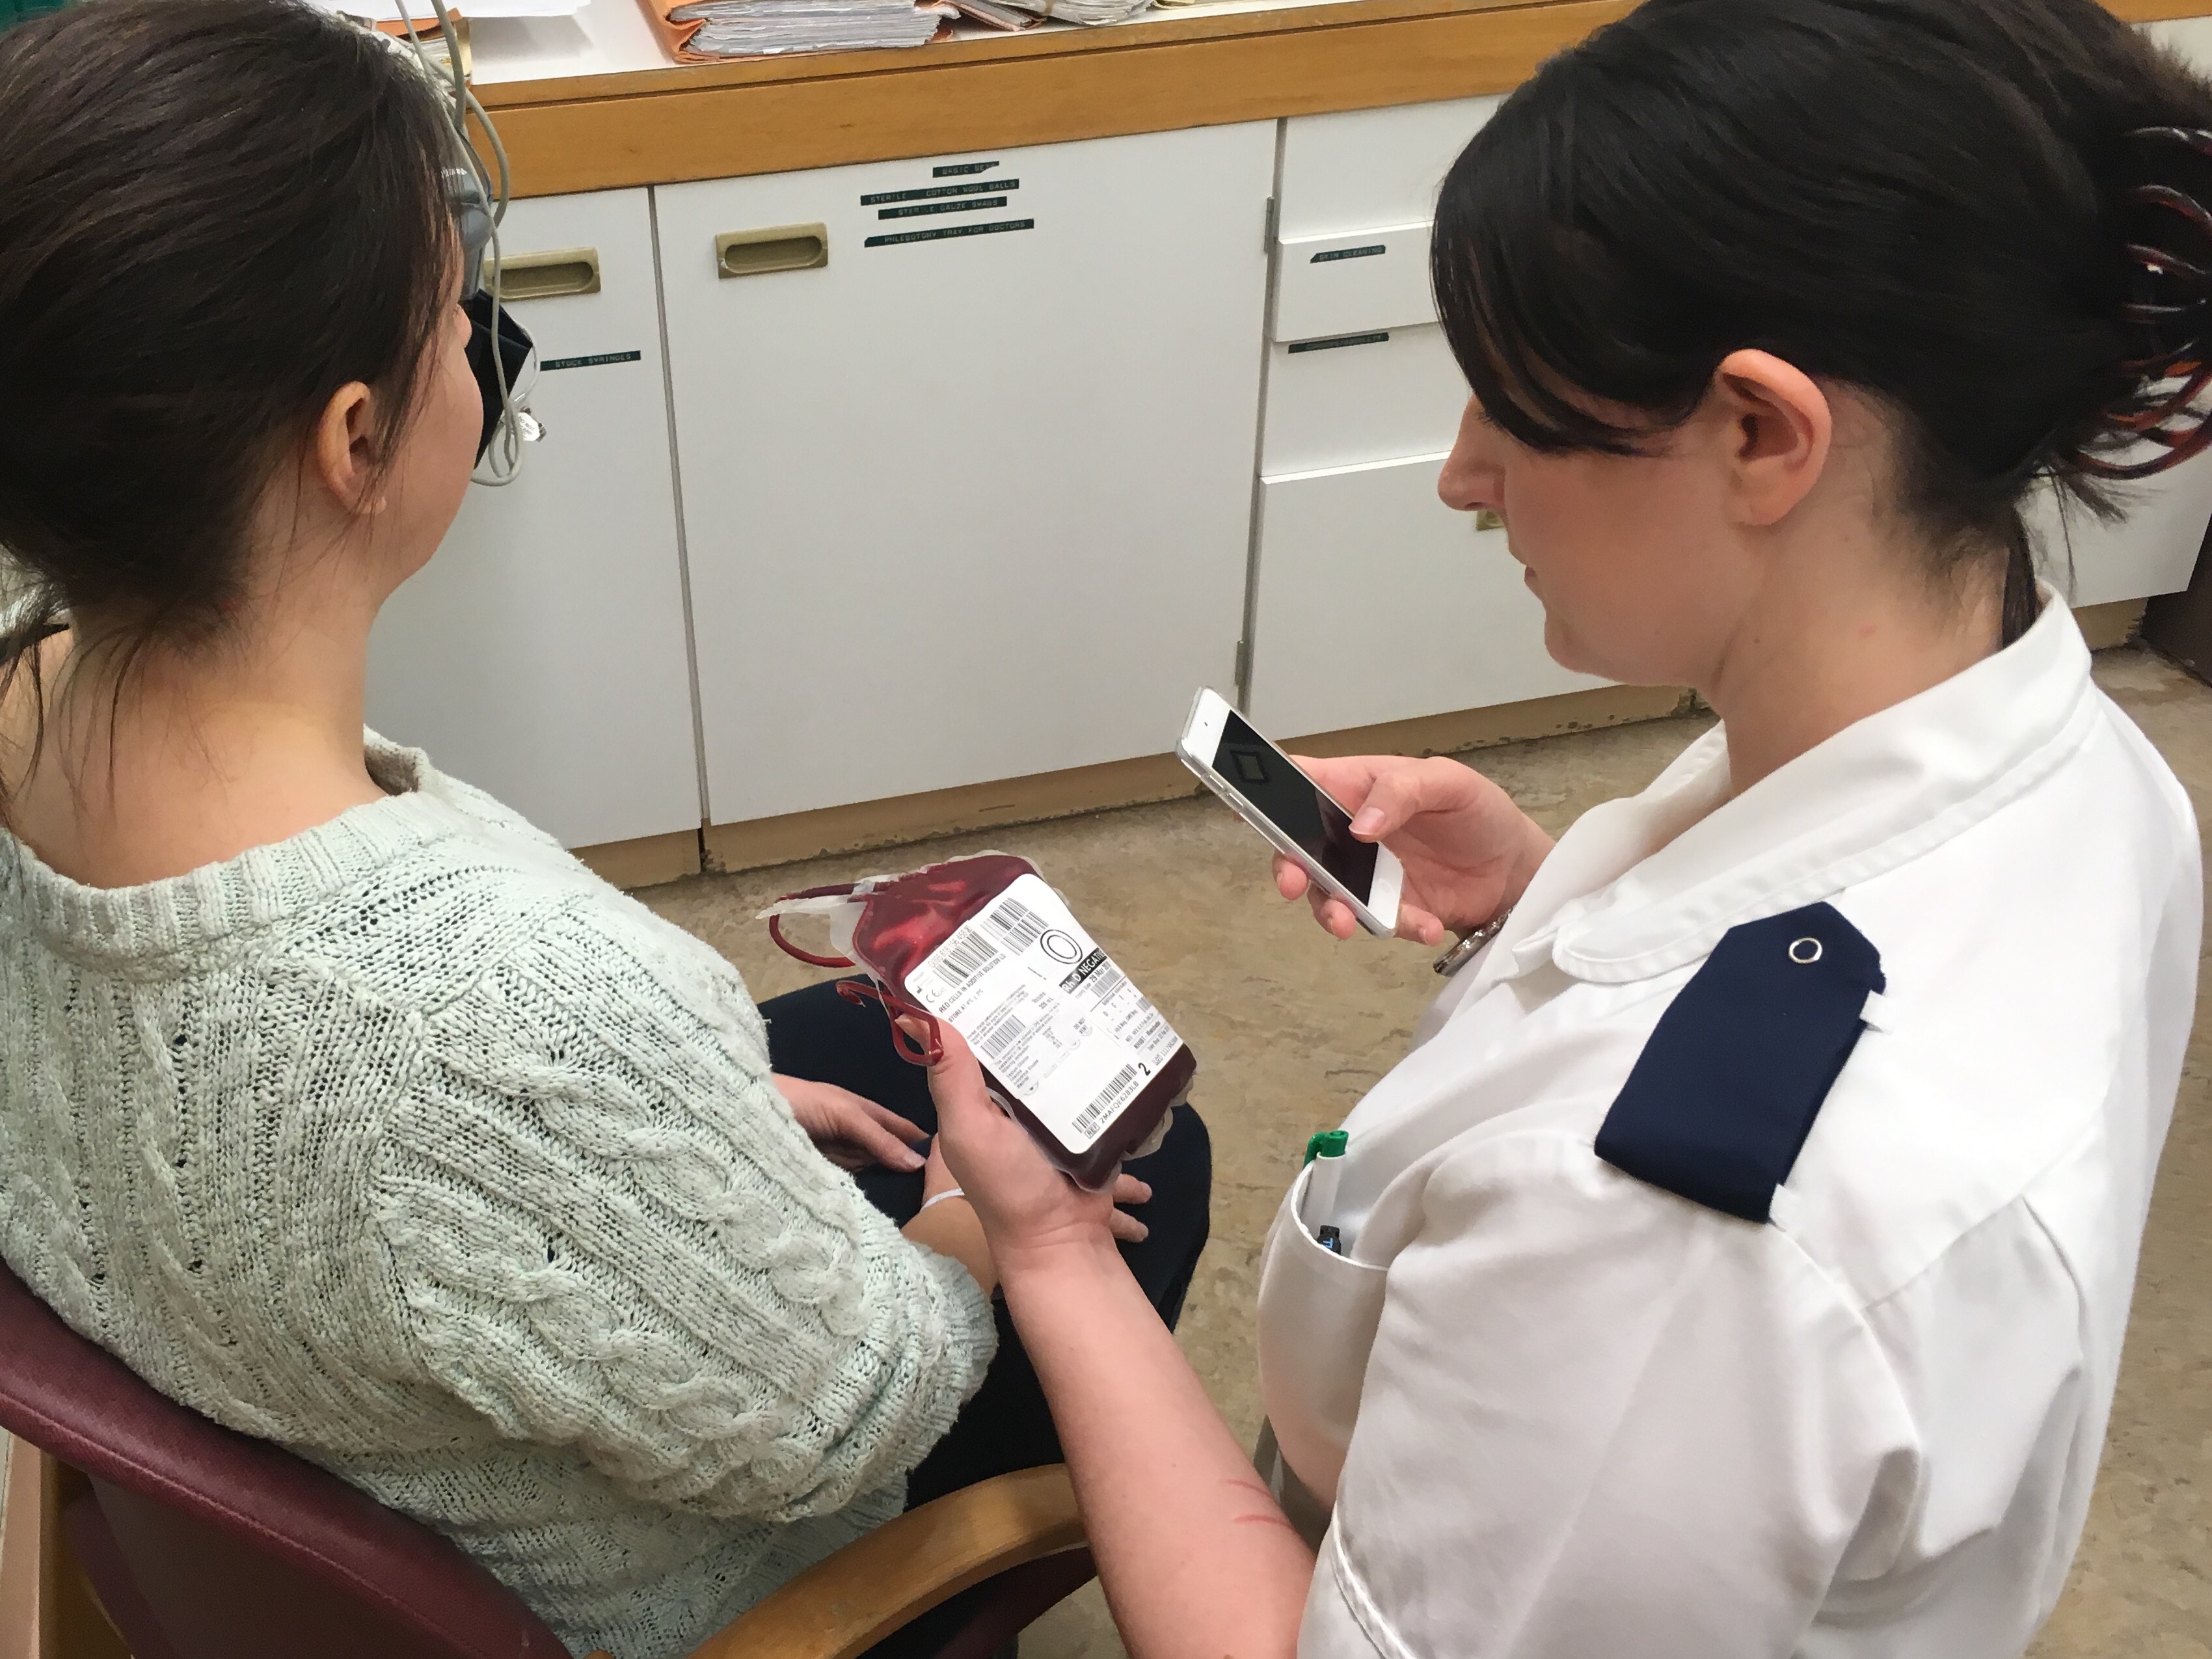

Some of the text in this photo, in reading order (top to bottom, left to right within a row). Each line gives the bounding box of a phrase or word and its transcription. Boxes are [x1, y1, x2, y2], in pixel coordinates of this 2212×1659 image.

[926, 187, 958, 197] COTTON
[963, 185, 983, 193] WOOL
[988, 182, 1016, 191] BALLS
[940, 202, 966, 212] GAUZE
[971, 199, 998, 208] SWABS
[884, 232, 936, 243] PHLEBOTOMY
[943, 228, 962, 237] TRAY
[989, 221, 1025, 232] DOCTORS
[1040, 929, 1083, 965] O
[1061, 979, 1075, 993] Rh
[1072, 971, 1082, 982] D
[1088, 974, 1097, 982] 29
[1094, 967, 1104, 977] Mar
[938, 1002, 950, 1013] RED
[948, 990, 962, 1003] CELLS
[965, 970, 984, 987] ADDITIVE
[982, 957, 1000, 973] SOLUTION
[1031, 991, 1046, 1003] Volume
[948, 1008, 962, 1022] STORE
[1138, 1062, 1151, 1076] 2
[1087, 1124, 1098, 1137] REF
